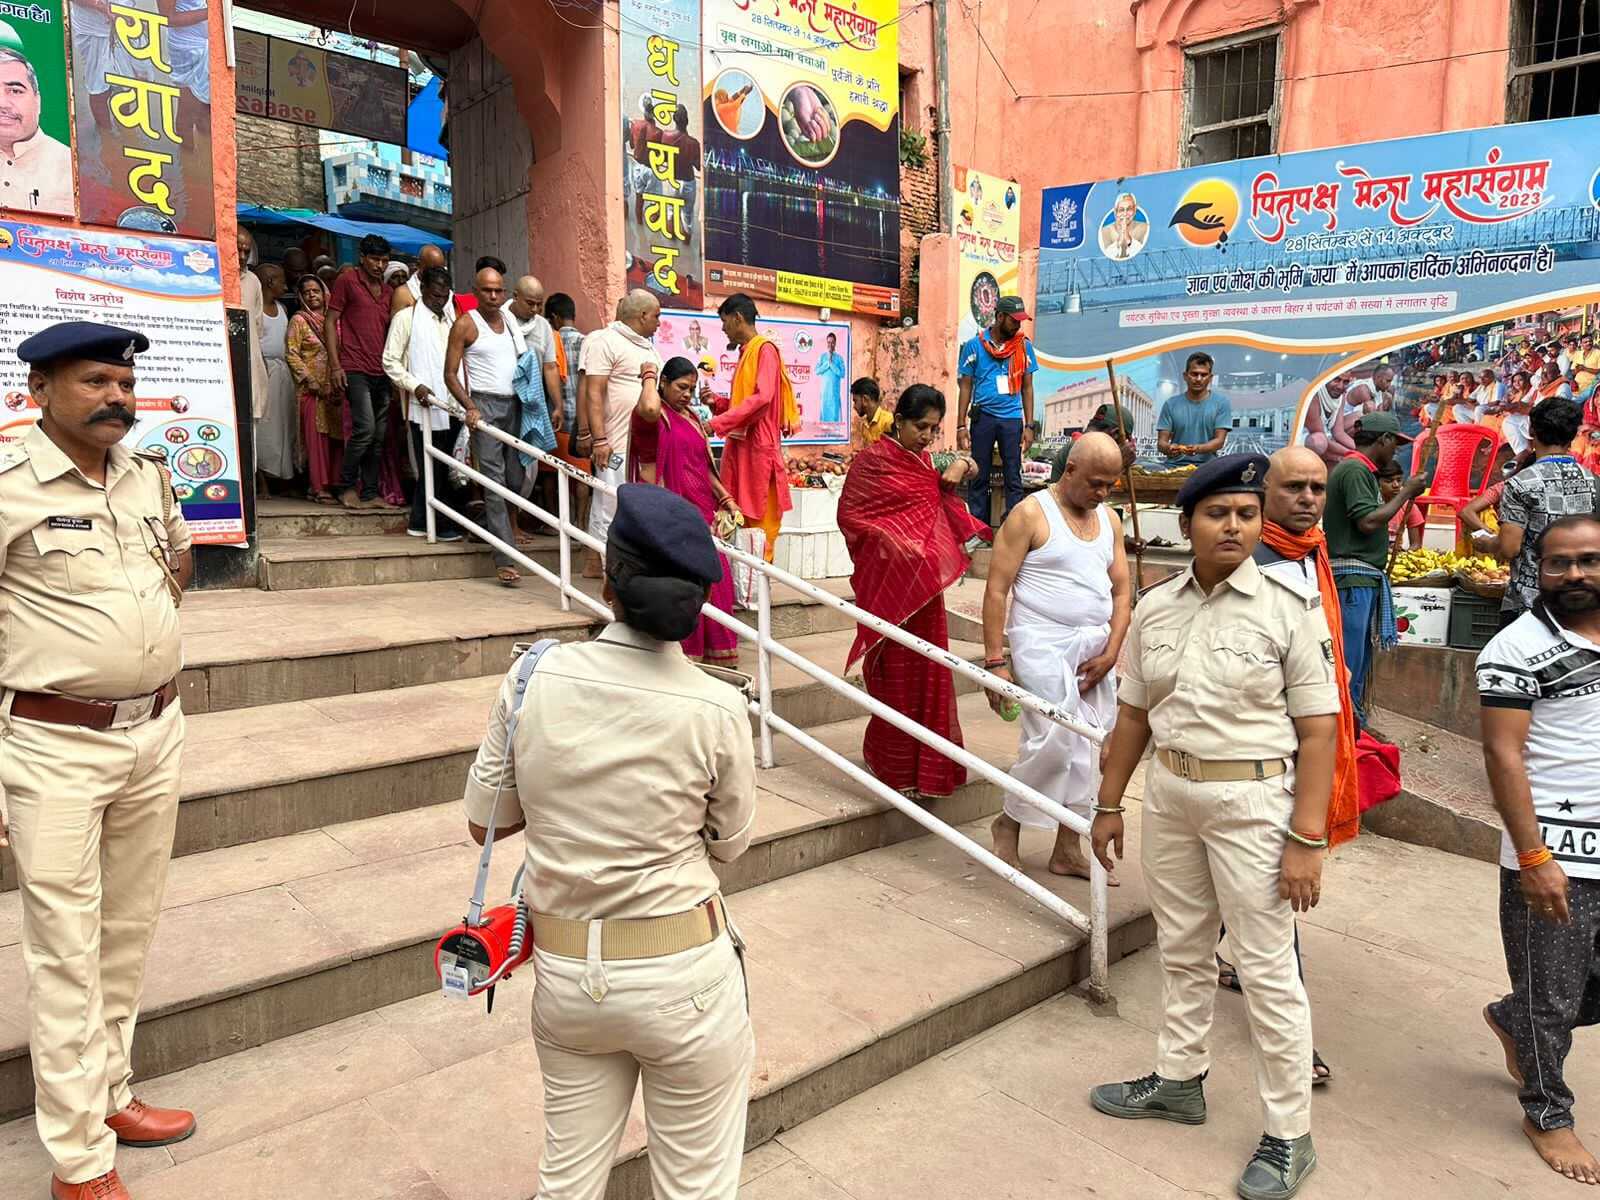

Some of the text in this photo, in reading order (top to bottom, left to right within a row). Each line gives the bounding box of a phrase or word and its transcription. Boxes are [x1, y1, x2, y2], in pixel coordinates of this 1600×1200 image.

[0, 3, 29, 18] गत
[720, 28, 737, 44] वृक्ष
[740, 35, 773, 54] लगाओ
[1250, 146, 1554, 244] पितृपक्ष मेला महासंगम
[1499, 192, 1541, 208] 2023
[1285, 226, 1454, 252] 28 सितम्बर से 14 अक्टूबर
[1187, 275, 1210, 294] ज्ञान
[1213, 270, 1228, 291] एवं
[1230, 267, 1256, 290] मोक्ष
[1258, 266, 1276, 288] की
[1278, 263, 1304, 293] भूमि
[1346, 259, 1358, 282] में
[1361, 261, 1405, 282] आपका
[1408, 252, 1453, 279] हार्दिक
[1456, 248, 1533, 276] अभिनन्दन
[1536, 244, 1554, 273] है।
[1346, 298, 1357, 311] की
[1395, 297, 1428, 309] लगातार
